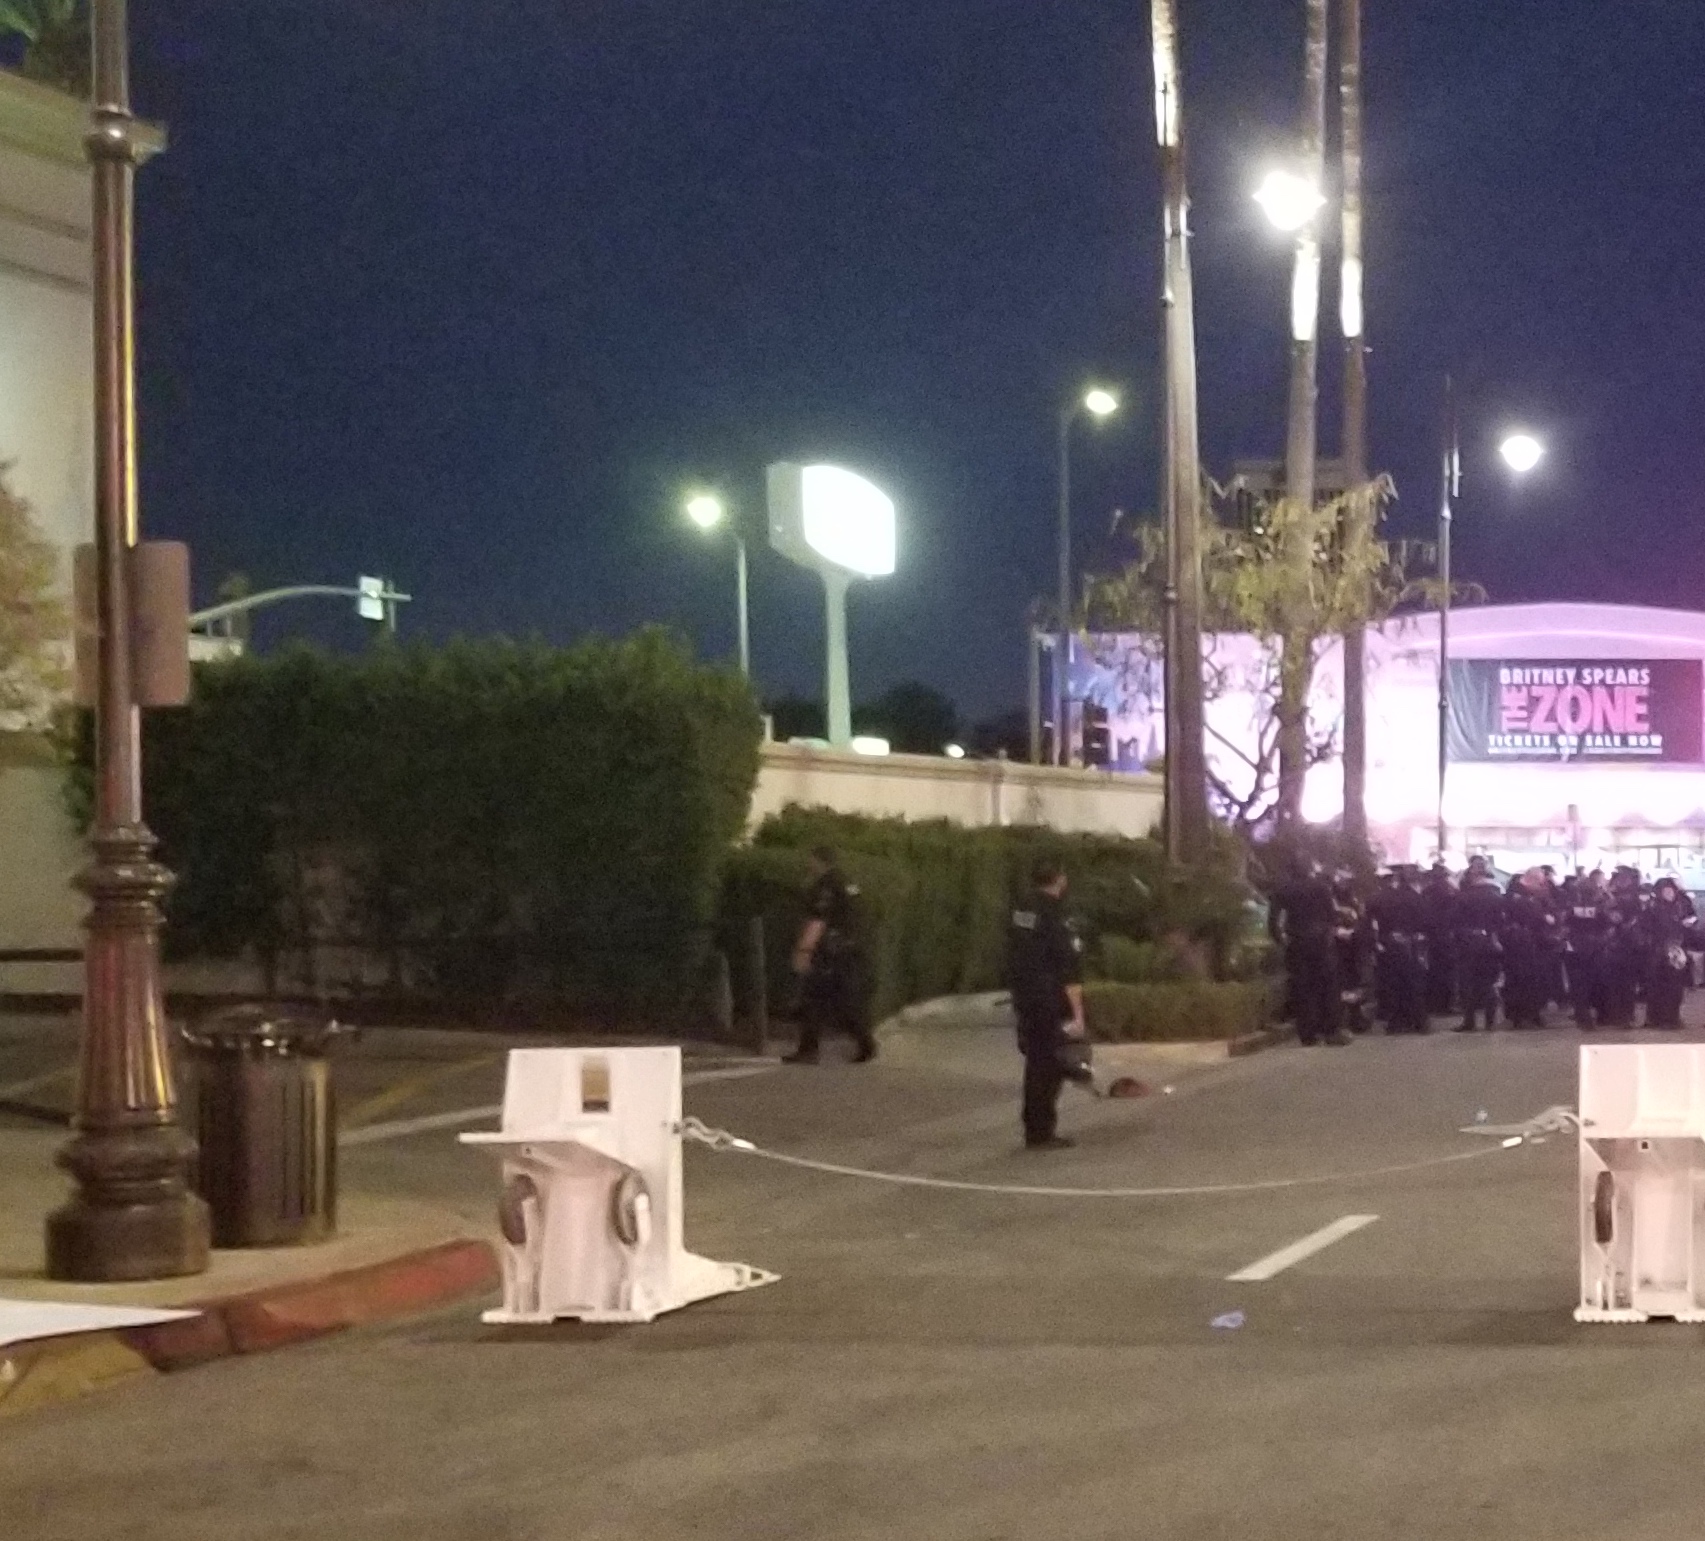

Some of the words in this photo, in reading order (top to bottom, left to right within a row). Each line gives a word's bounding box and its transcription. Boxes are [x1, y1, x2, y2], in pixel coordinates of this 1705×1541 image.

[1499, 667, 1577, 685] BRITNEY
[1581, 667, 1650, 685] SPEARS
[1501, 685, 1529, 733] THE
[1530, 684, 1650, 735] ZONE
[1488, 734, 1550, 747] TICKETS
[1557, 734, 1578, 747] ON
[1585, 734, 1622, 747] SALE
[1627, 734, 1663, 747] NOW
